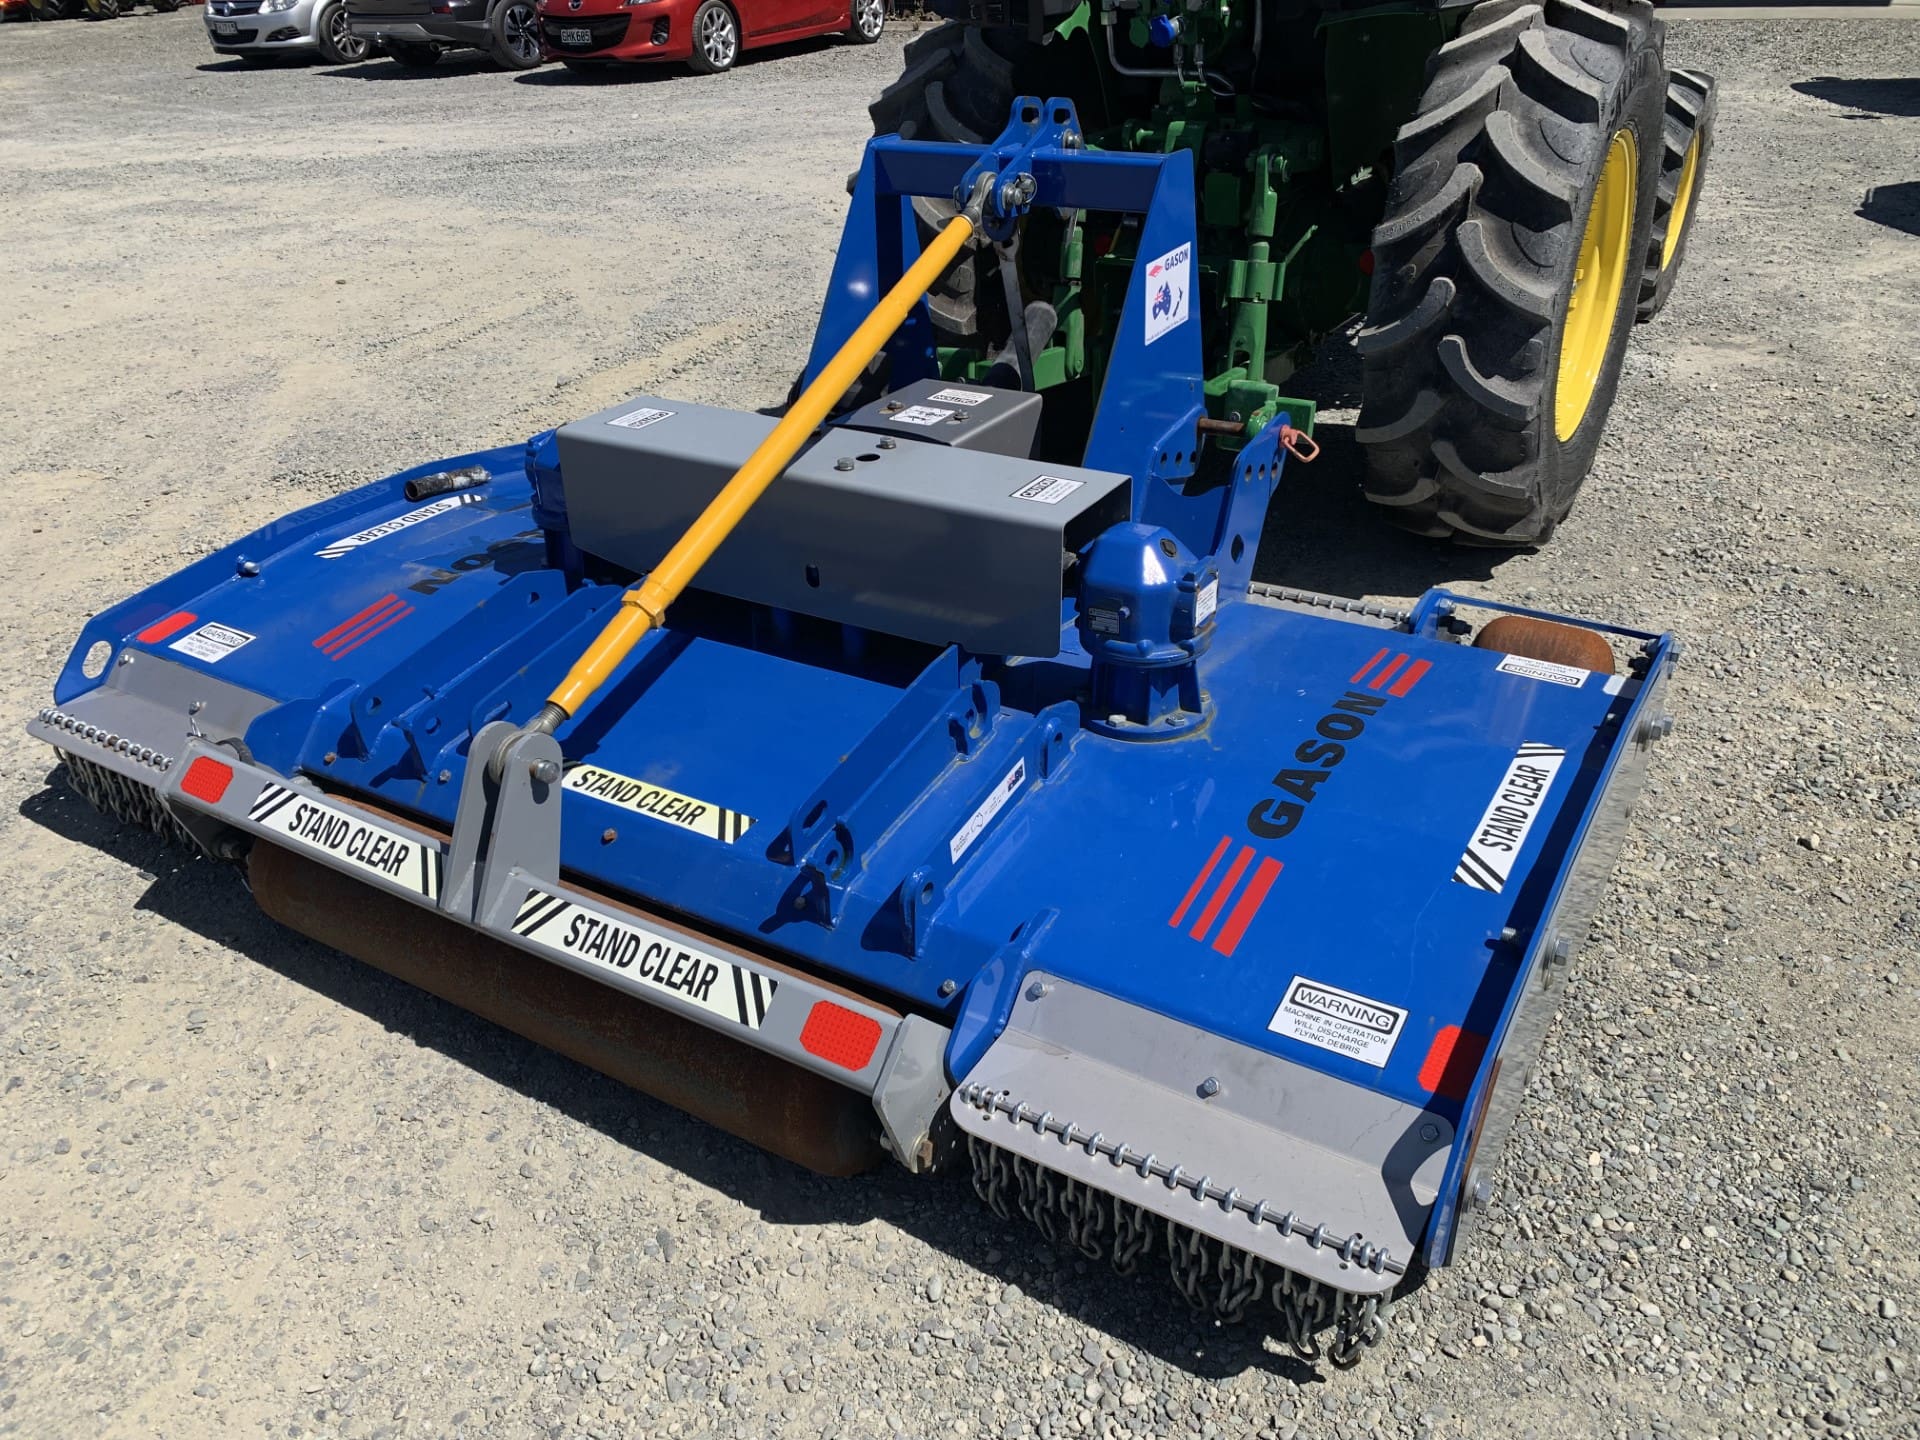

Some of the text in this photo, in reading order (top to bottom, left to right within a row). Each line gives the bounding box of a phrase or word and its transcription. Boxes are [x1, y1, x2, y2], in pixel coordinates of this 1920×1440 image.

[1164, 247, 1189, 271] GASON
[351, 521, 405, 542] CLEAR
[402, 502, 452, 523] STAND
[1506, 664, 1574, 683] WARNING
[1247, 691, 1388, 839] GASON
[572, 770, 706, 826] STAND CLEAR
[1478, 764, 1550, 852] STAND CLEAR
[288, 803, 410, 877] STAND CLEAR
[563, 913, 719, 1002] STAND CLEAR
[1283, 1006, 1388, 1045] MACHINE IN OPERATION
[1299, 989, 1391, 1028] WARNING
[1294, 1018, 1370, 1049] WILL DISCHARGE
[1294, 1027, 1361, 1055] FLYING DEBRIS
